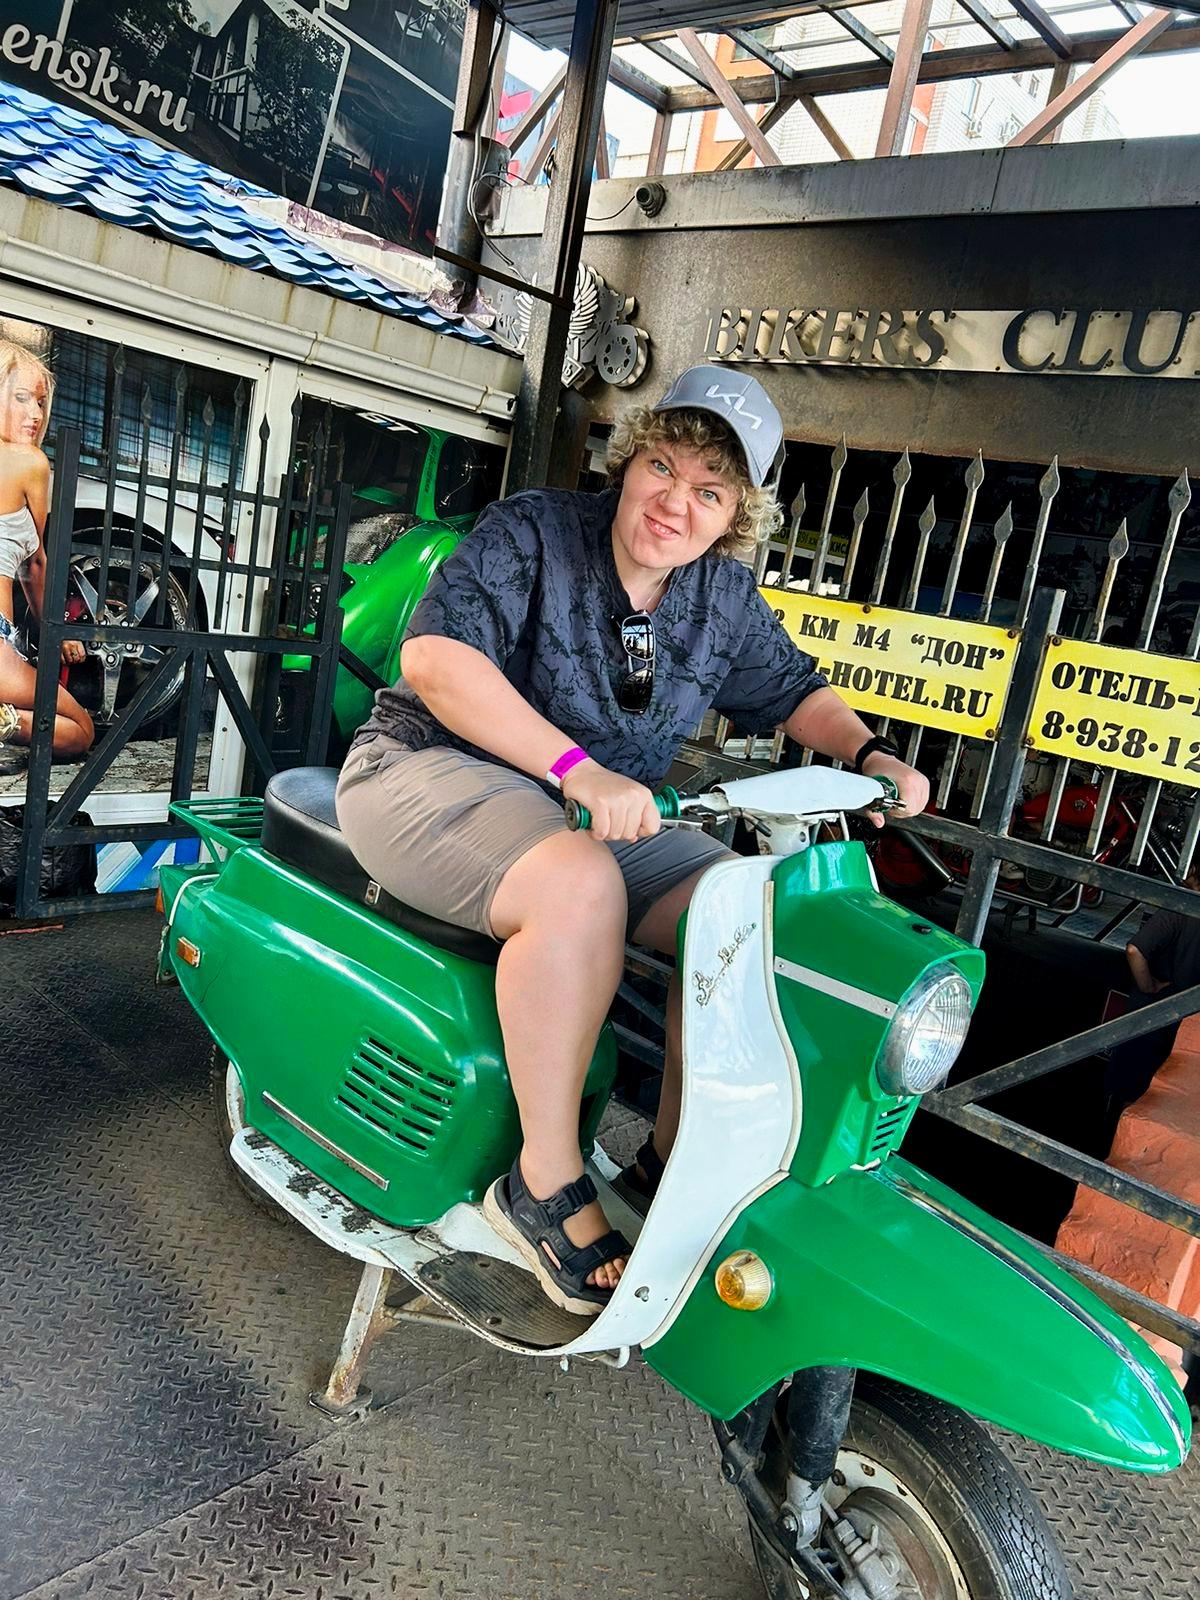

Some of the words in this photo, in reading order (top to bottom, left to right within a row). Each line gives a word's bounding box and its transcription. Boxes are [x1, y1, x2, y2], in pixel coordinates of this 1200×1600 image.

[1, 24, 188, 133] ensk.ru
[704, 306, 950, 367] BIKERS
[799, 613, 840, 642] КМ
[853, 623, 892, 652] М4
[813, 656, 994, 718] -HOTEL.RU
[1051, 661, 1200, 717] ОТЕЛЬ-
